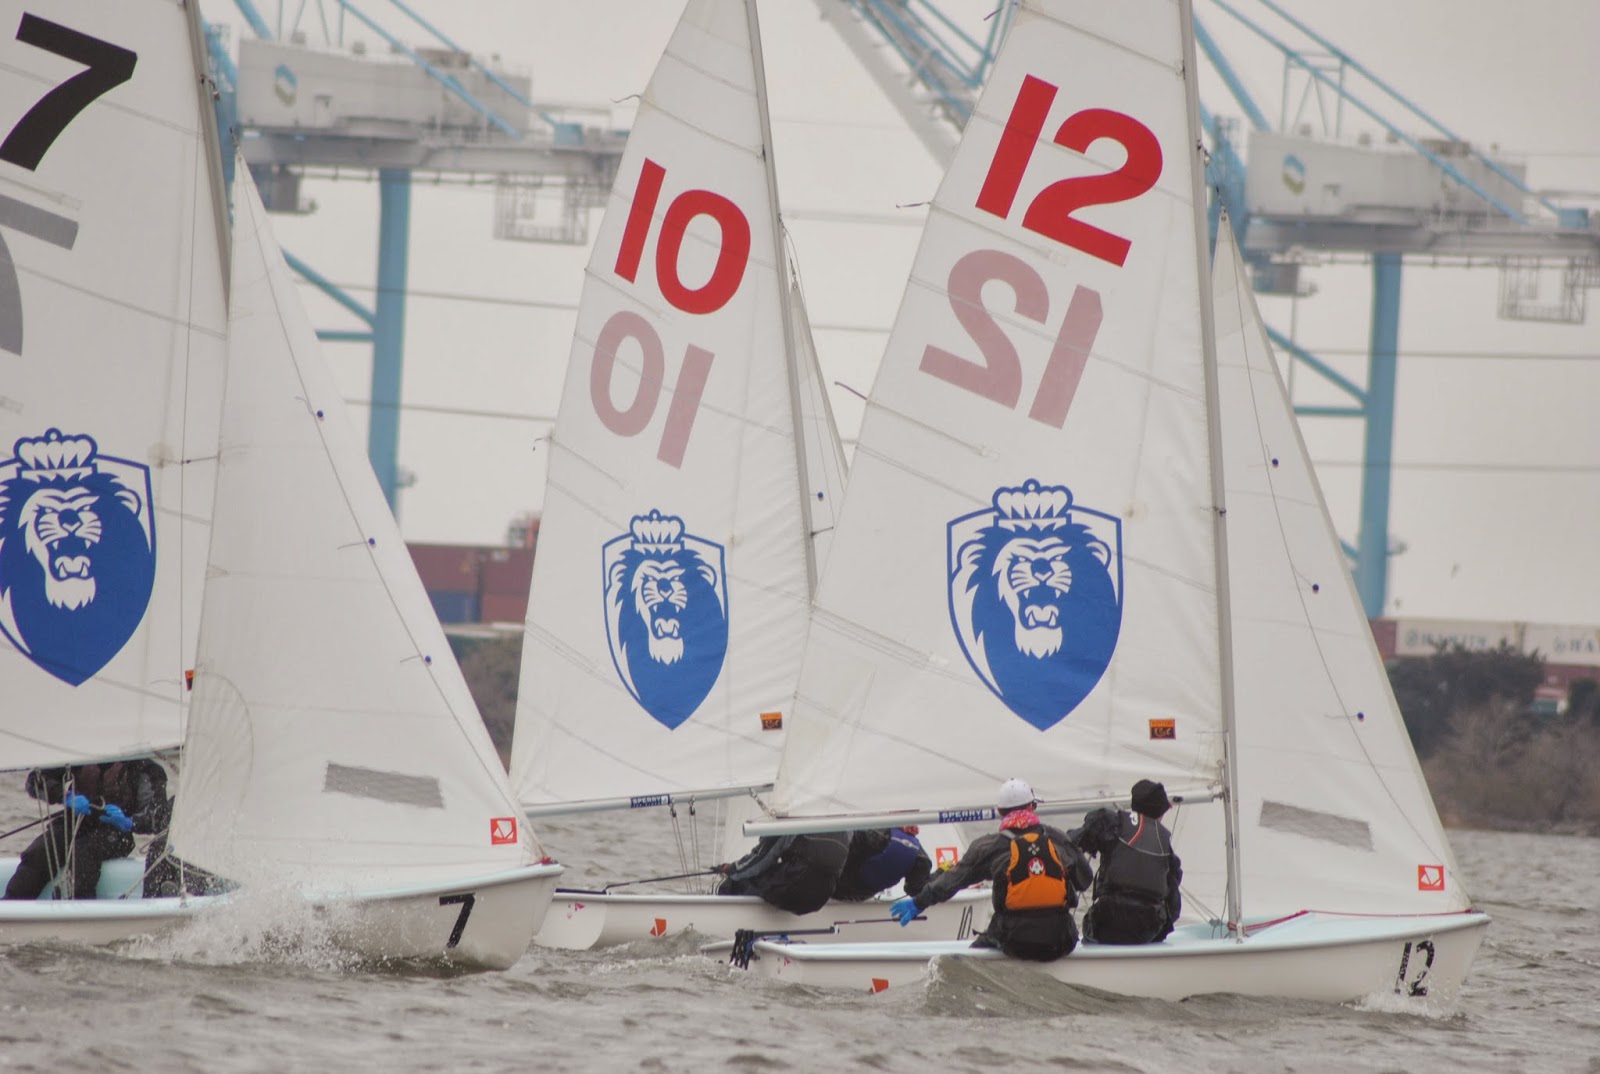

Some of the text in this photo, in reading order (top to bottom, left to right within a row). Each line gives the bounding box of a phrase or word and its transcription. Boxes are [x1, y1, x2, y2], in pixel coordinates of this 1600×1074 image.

[0, 11, 138, 172] 7
[976, 74, 1163, 267] 12
[614, 158, 751, 315] 10
[941, 809, 982, 818] SPERRY
[438, 892, 476, 949] 7
[1394, 940, 1435, 997] 12
